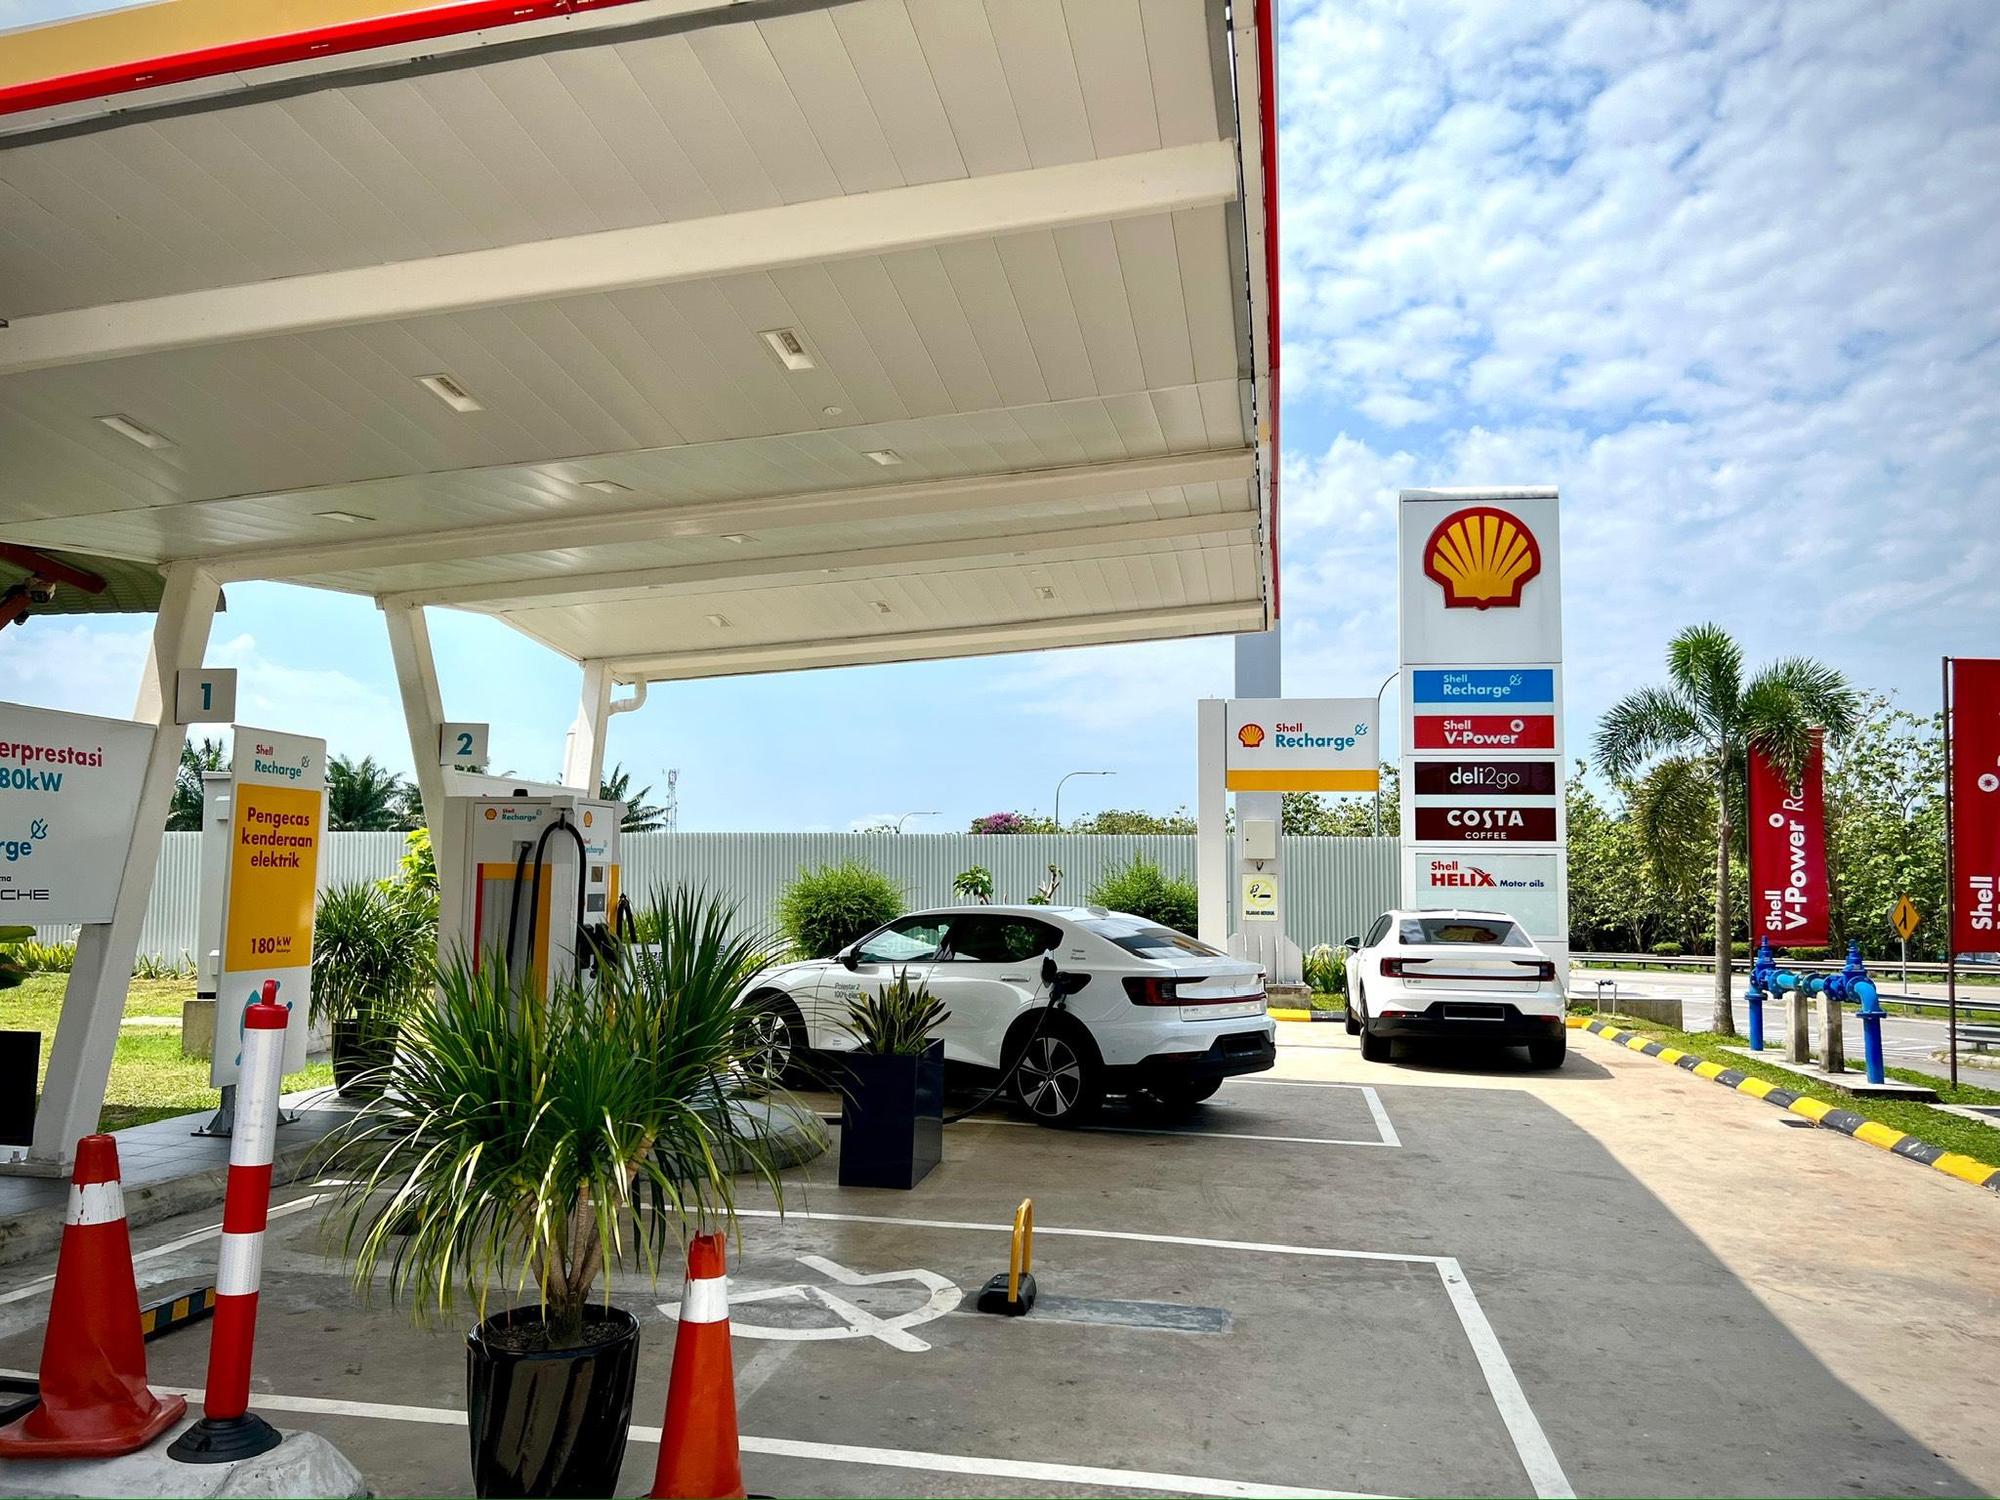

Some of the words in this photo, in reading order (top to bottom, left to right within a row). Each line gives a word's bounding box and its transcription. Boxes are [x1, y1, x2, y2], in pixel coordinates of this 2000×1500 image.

[1443, 674, 1468, 683] Shell
[200, 682, 212, 710] 1
[1443, 683, 1511, 698] Recharge
[1276, 723, 1303, 733] Shell
[1443, 720, 1471, 730] Shell
[456, 733, 473, 755] 2
[1275, 733, 1355, 752] Recharge
[1444, 731, 1519, 745] V-Power
[255, 744, 274, 756] Shell
[254, 760, 302, 780] Recharge
[1449, 766, 1520, 790] deli2go
[247, 806, 310, 829] Pengecas
[502, 813, 537, 822] Recharge
[1447, 810, 1524, 829] COSTA
[1465, 832, 1507, 840] COFFEE
[250, 852, 300, 869] elektrik
[1431, 861, 1458, 871] Shell
[1431, 871, 1497, 887] HELIX
[1500, 880, 1527, 888] Motor
[1529, 880, 1545, 888] oils
[1784, 820, 1808, 931] V-Power
[1764, 890, 1782, 931] Shell
[1969, 875, 1994, 930] Shell
[251, 937, 275, 954] 180
